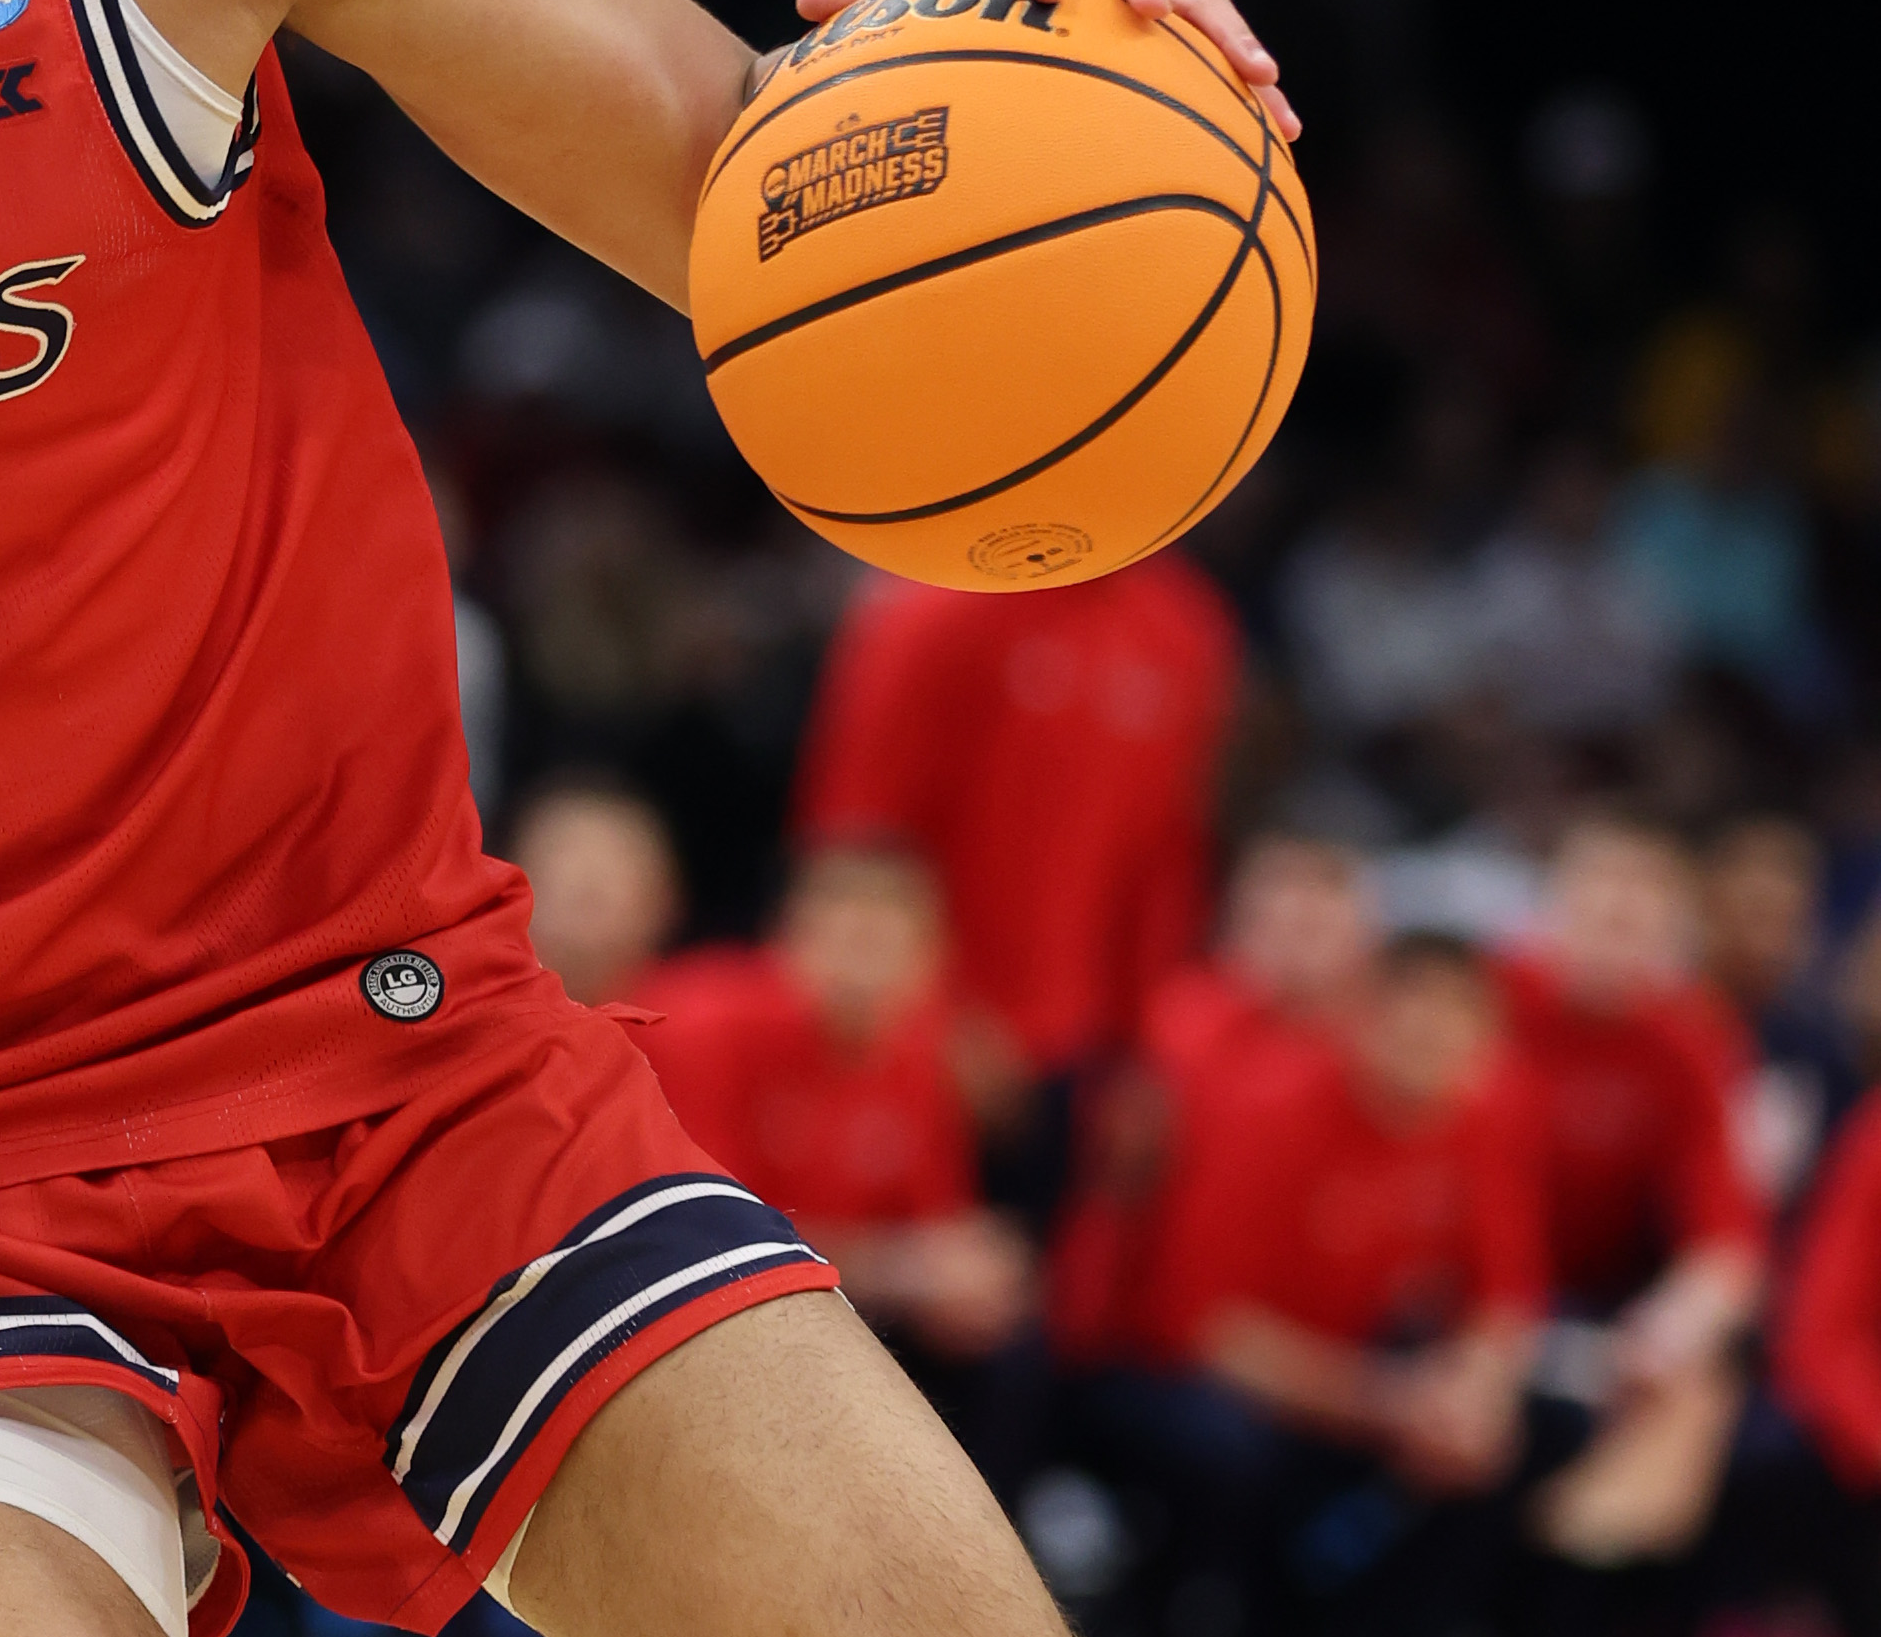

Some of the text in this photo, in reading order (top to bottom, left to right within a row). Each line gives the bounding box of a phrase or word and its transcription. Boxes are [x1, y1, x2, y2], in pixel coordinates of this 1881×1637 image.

[787, 126, 890, 192] MARCH
[801, 146, 946, 221] MADNESS
[385, 969, 418, 989] LG
[379, 990, 437, 1015] AUTHENTIC
